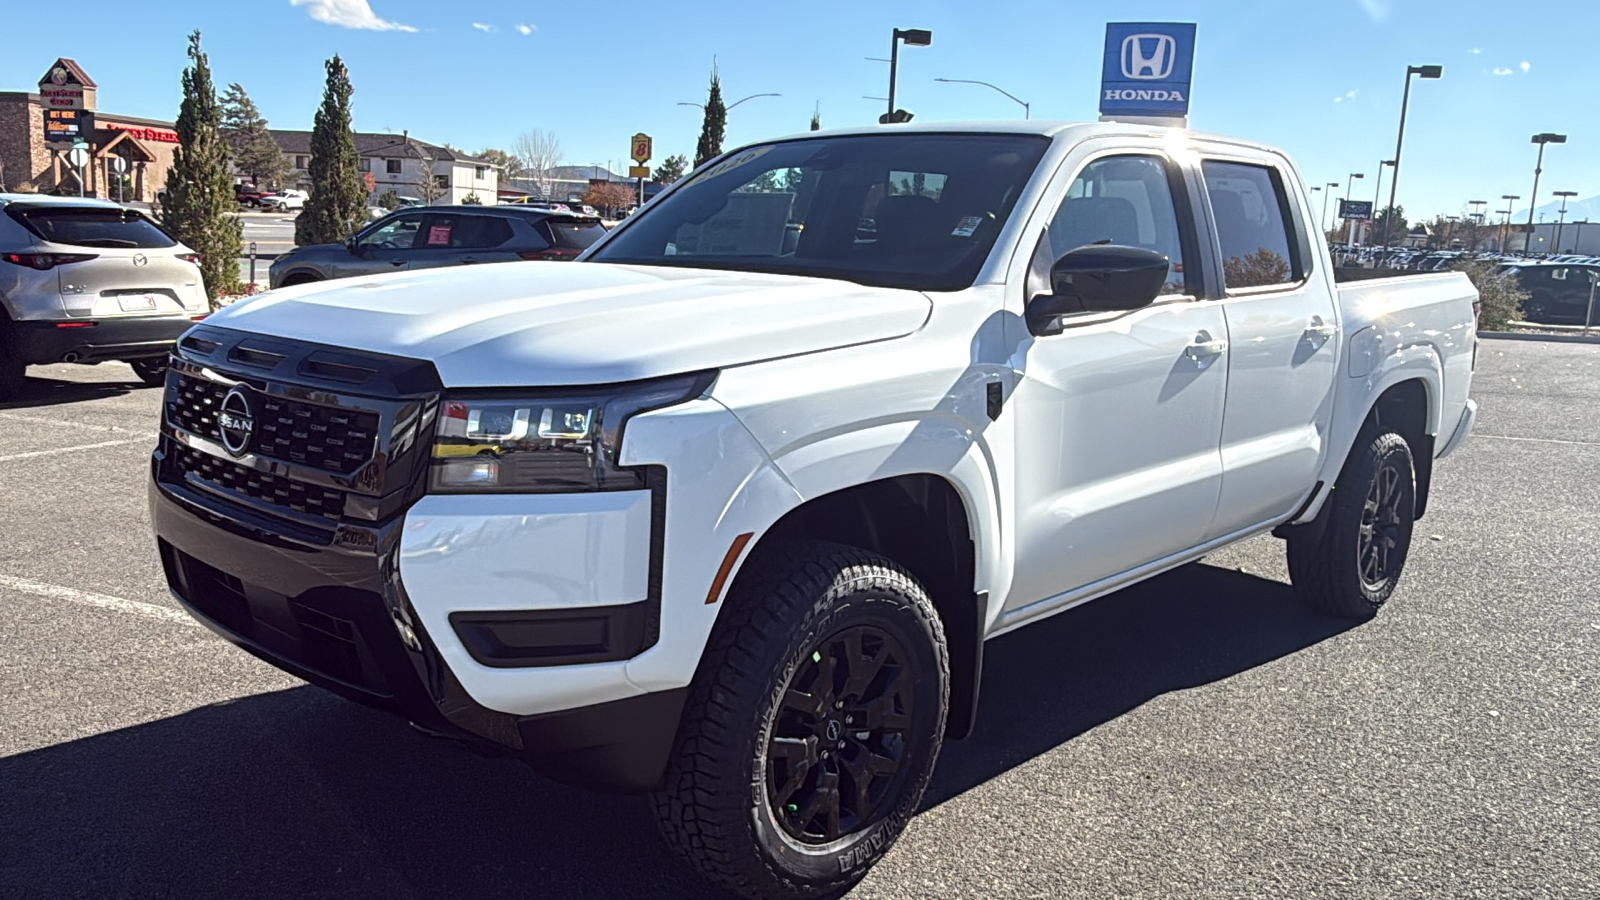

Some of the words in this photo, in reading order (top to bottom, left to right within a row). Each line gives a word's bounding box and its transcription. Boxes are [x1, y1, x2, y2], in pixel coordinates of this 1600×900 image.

[1105, 89, 1185, 101] HONDA
[145, 128, 180, 143] STRIK
[636, 142, 646, 157] 8
